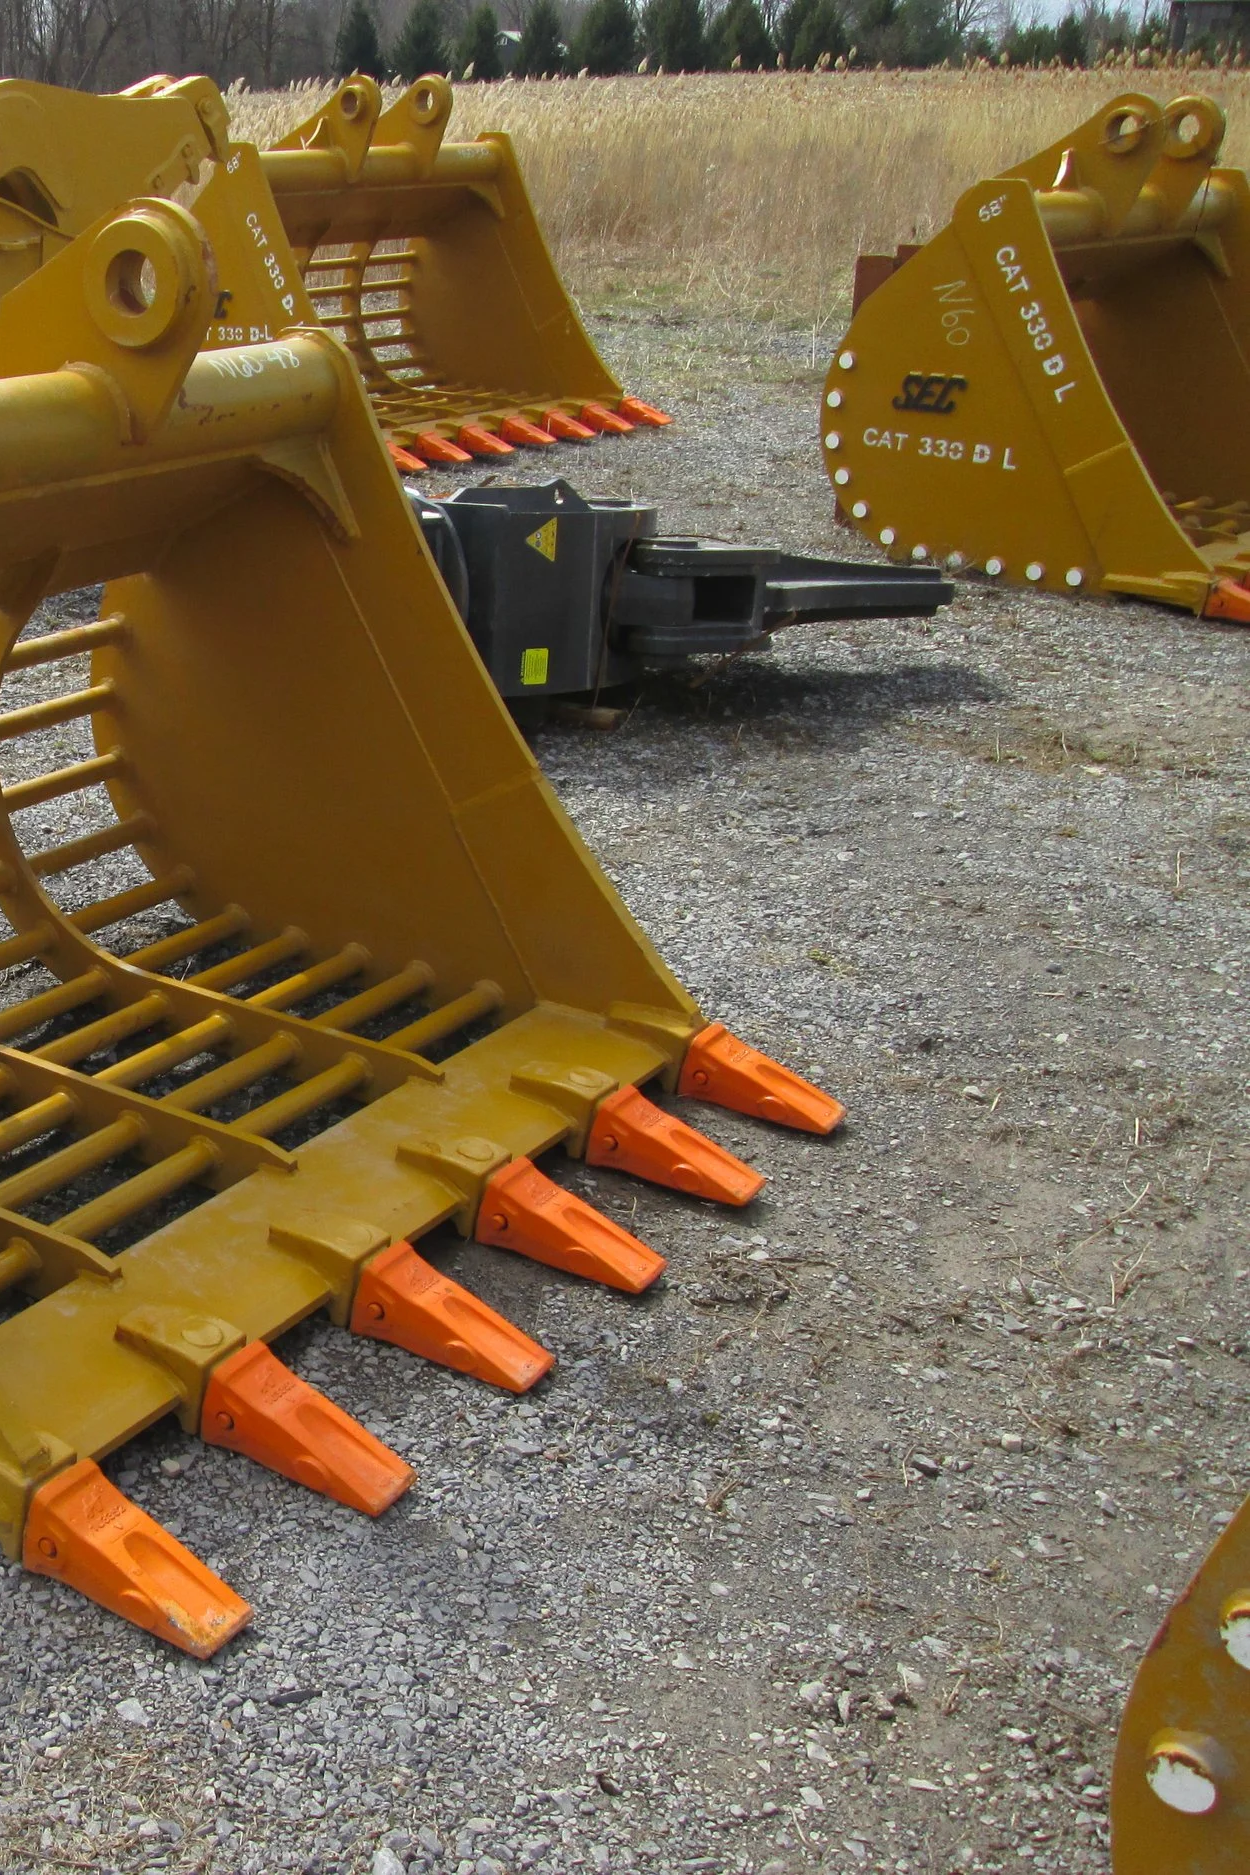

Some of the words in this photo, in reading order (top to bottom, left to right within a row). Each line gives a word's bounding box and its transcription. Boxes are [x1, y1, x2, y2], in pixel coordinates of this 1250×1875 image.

[246, 212, 268, 248] CAT
[264, 252, 285, 290] 330
[996, 246, 1030, 293] CAT
[1020, 301, 1053, 351] 330
[217, 326, 244, 341] 330
[891, 370, 969, 415] SEC
[862, 427, 909, 451] CAT
[917, 436, 964, 460] 330
